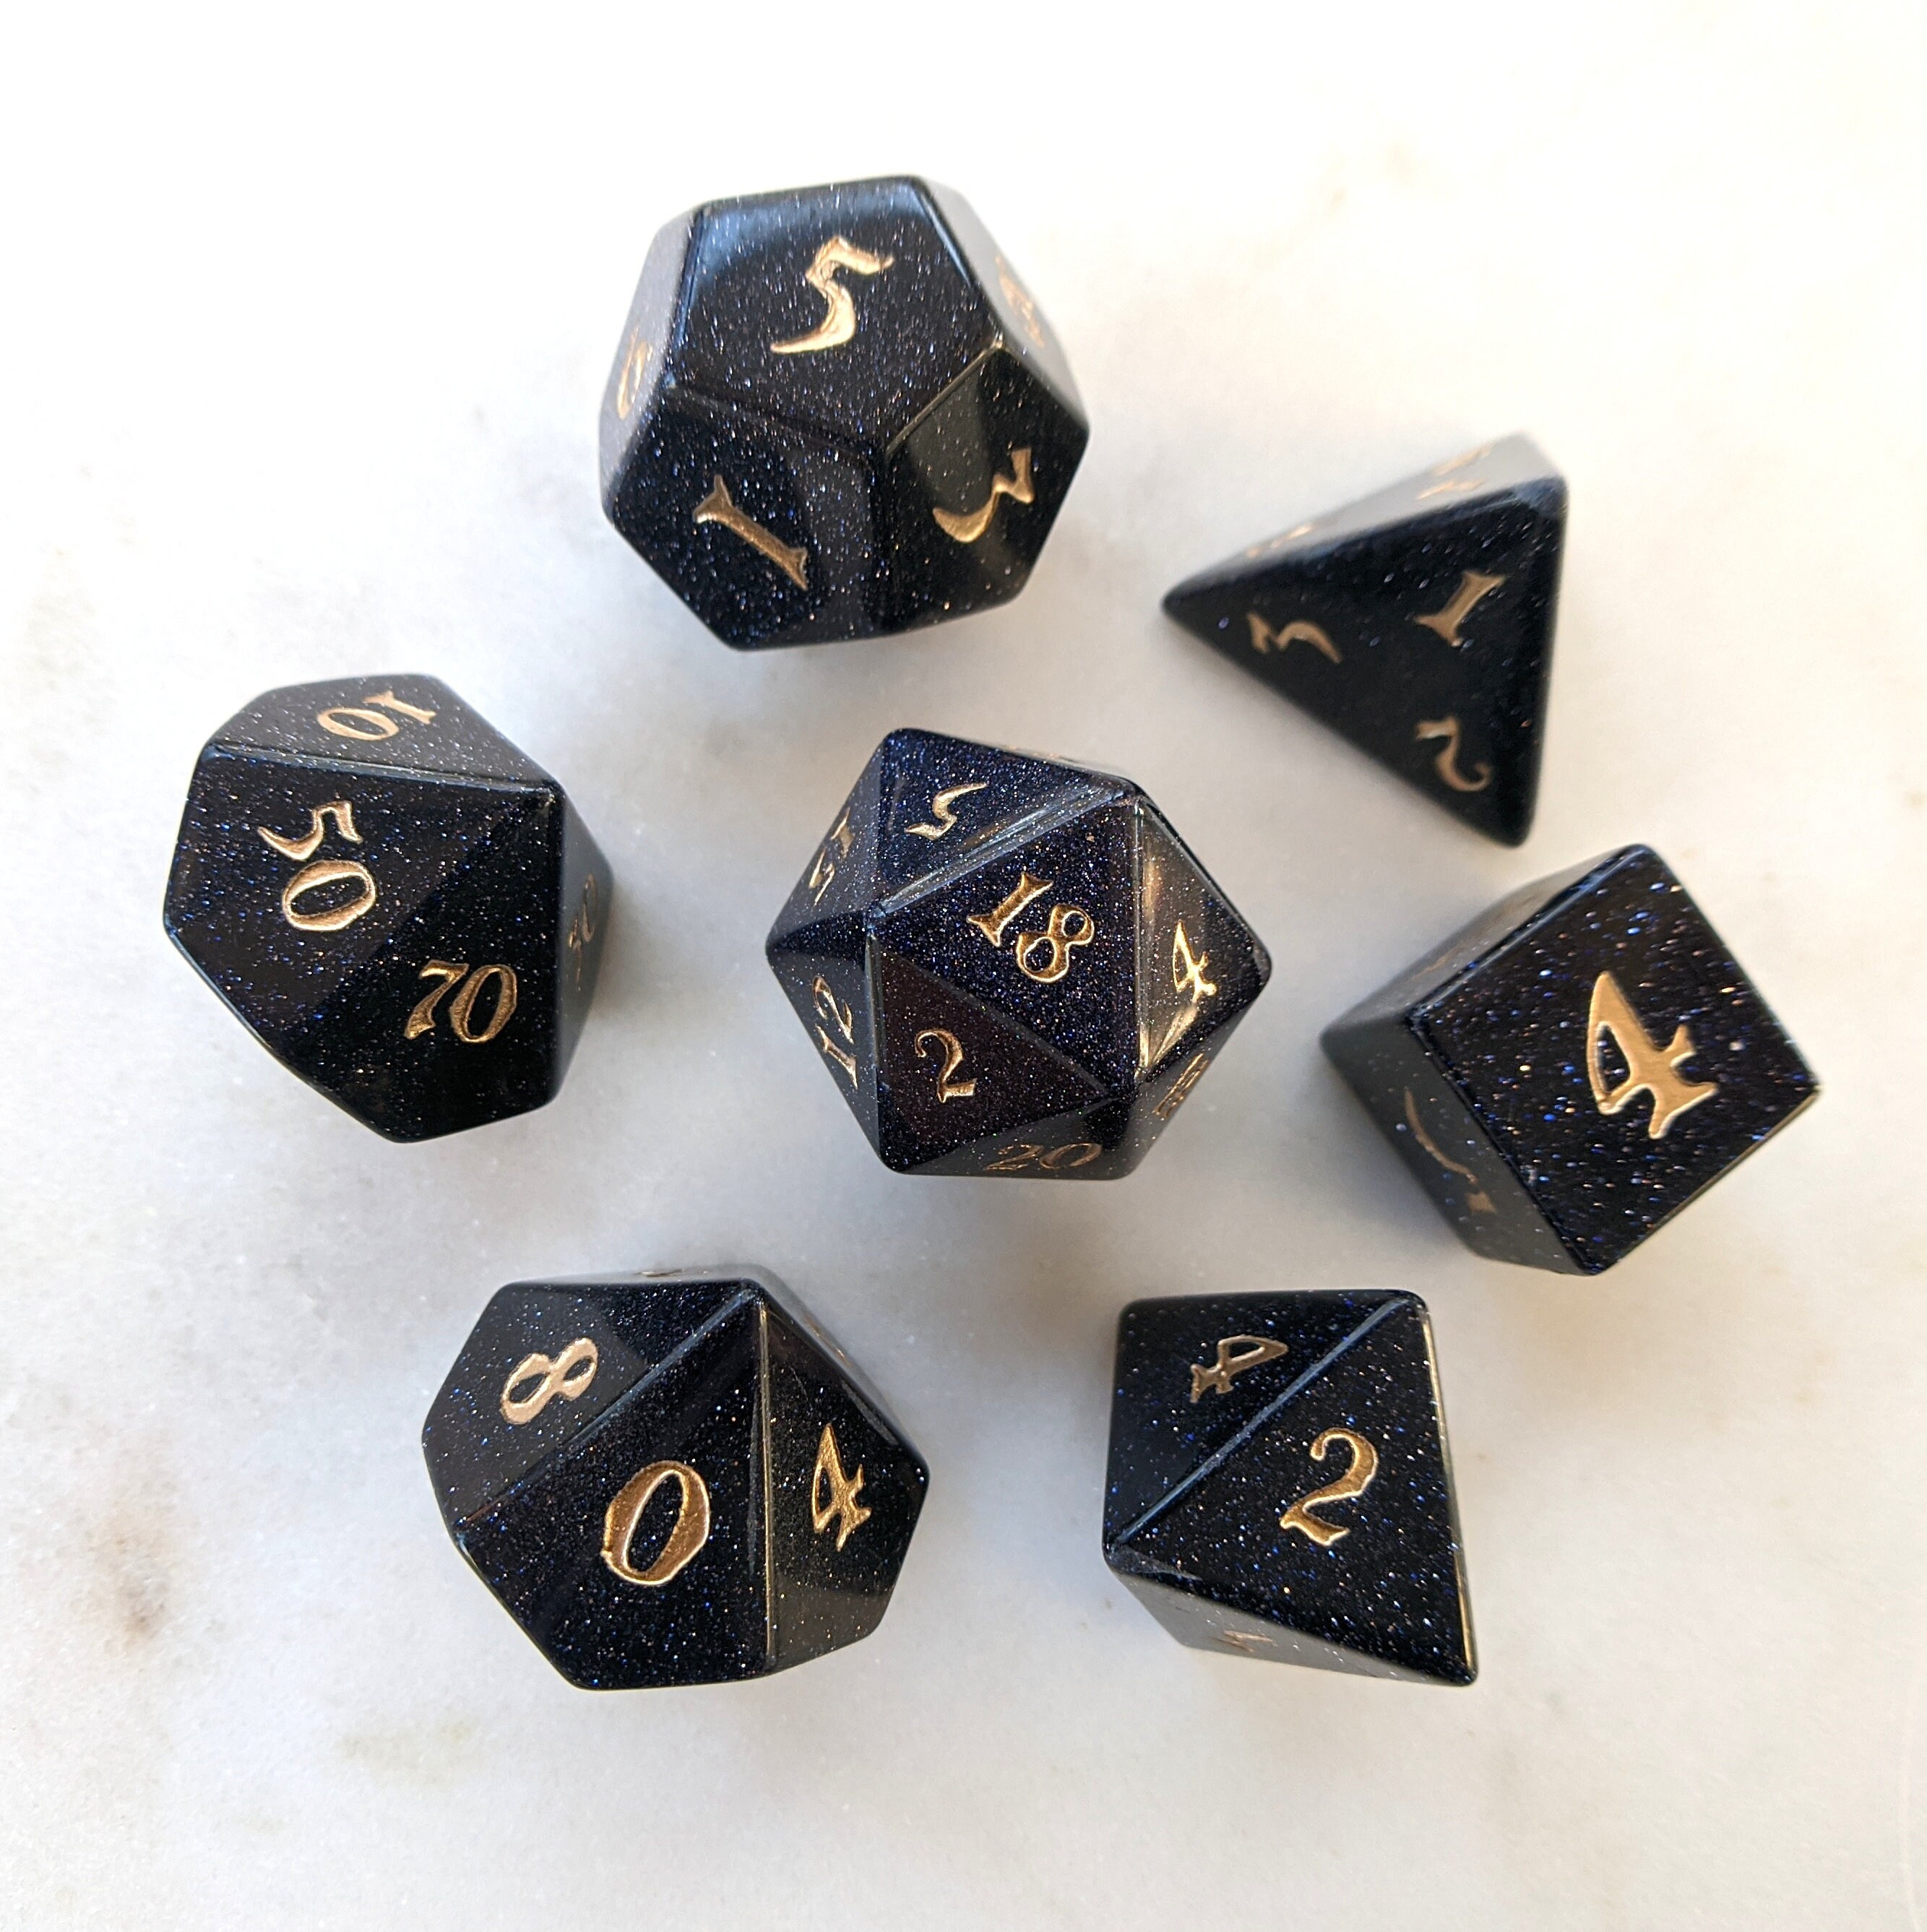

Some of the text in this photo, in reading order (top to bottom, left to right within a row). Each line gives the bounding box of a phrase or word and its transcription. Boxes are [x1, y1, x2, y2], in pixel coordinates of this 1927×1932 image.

[770, 236, 895, 354] 5
[693, 474, 809, 591] 1
[931, 447, 1035, 544] 3
[1413, 571, 1508, 648] 1
[316, 689, 437, 742] 10
[1415, 716, 1494, 793] 2
[904, 781, 989, 842] 5
[256, 800, 379, 932] 50
[966, 870, 1097, 984] 18
[1172, 919, 1218, 999] 4
[402, 959, 519, 1044] 70
[812, 975, 858, 1090] 12
[913, 1027, 979, 1104] 2
[1586, 970, 1720, 1140] 4
[983, 1142, 1103, 1172] 20
[500, 1336, 600, 1426] 8
[1189, 1334, 1290, 1404] 4
[600, 1459, 712, 1587] 0
[810, 1422, 873, 1552] 4
[1280, 1428, 1379, 1547] 2
